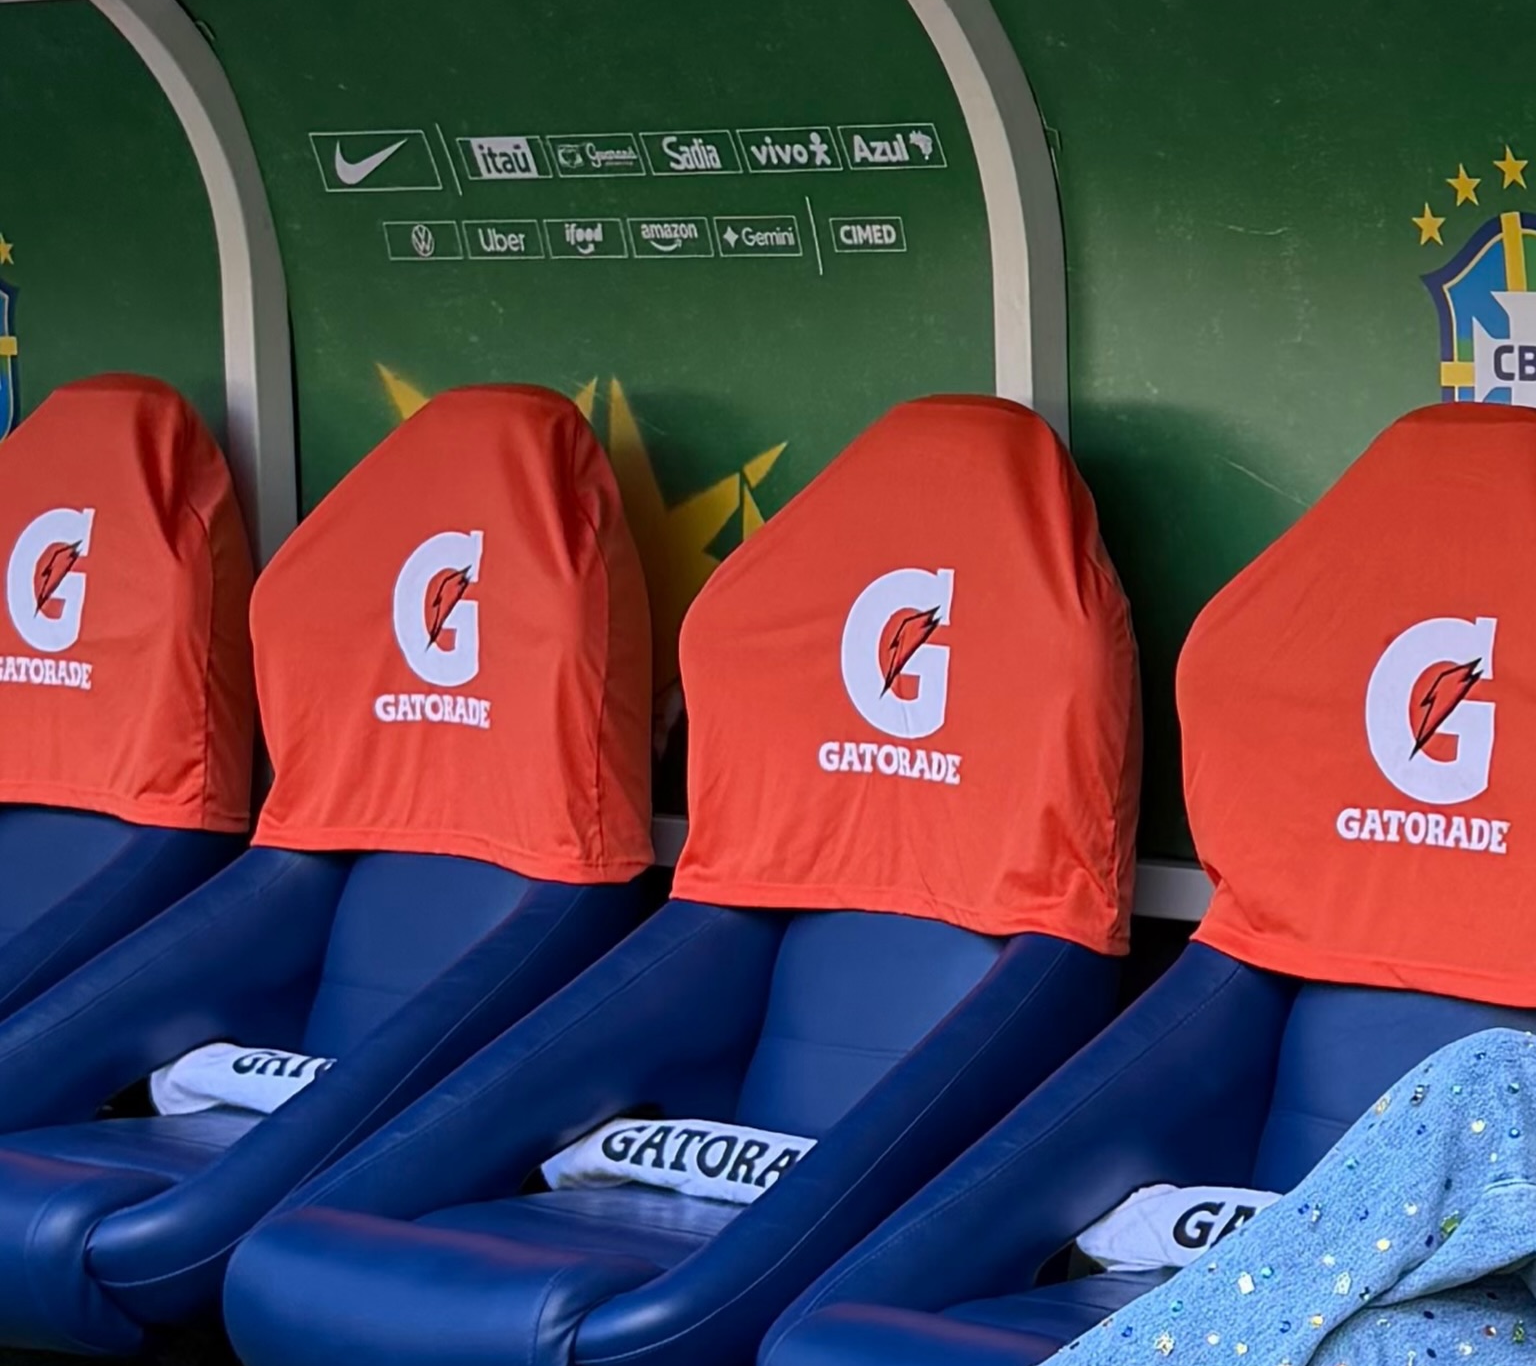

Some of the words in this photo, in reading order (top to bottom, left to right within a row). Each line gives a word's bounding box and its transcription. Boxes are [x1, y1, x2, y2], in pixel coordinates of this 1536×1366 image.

[662, 136, 722, 170] Sadia
[750, 136, 808, 165] vivo
[853, 133, 910, 163] Azul
[478, 228, 526, 252] Uber
[640, 223, 699, 239] amazon
[741, 227, 795, 247] Gemini
[839, 224, 897, 245] CIMED
[6, 507, 96, 653] G
[392, 530, 484, 687] G
[840, 567, 955, 739] G
[374, 693, 492, 729] GATORADE
[1365, 616, 1498, 805] G
[818, 741, 962, 785] GATORADE
[1336, 807, 1511, 854] GATORADE
[601, 1124, 801, 1189] GATORA
